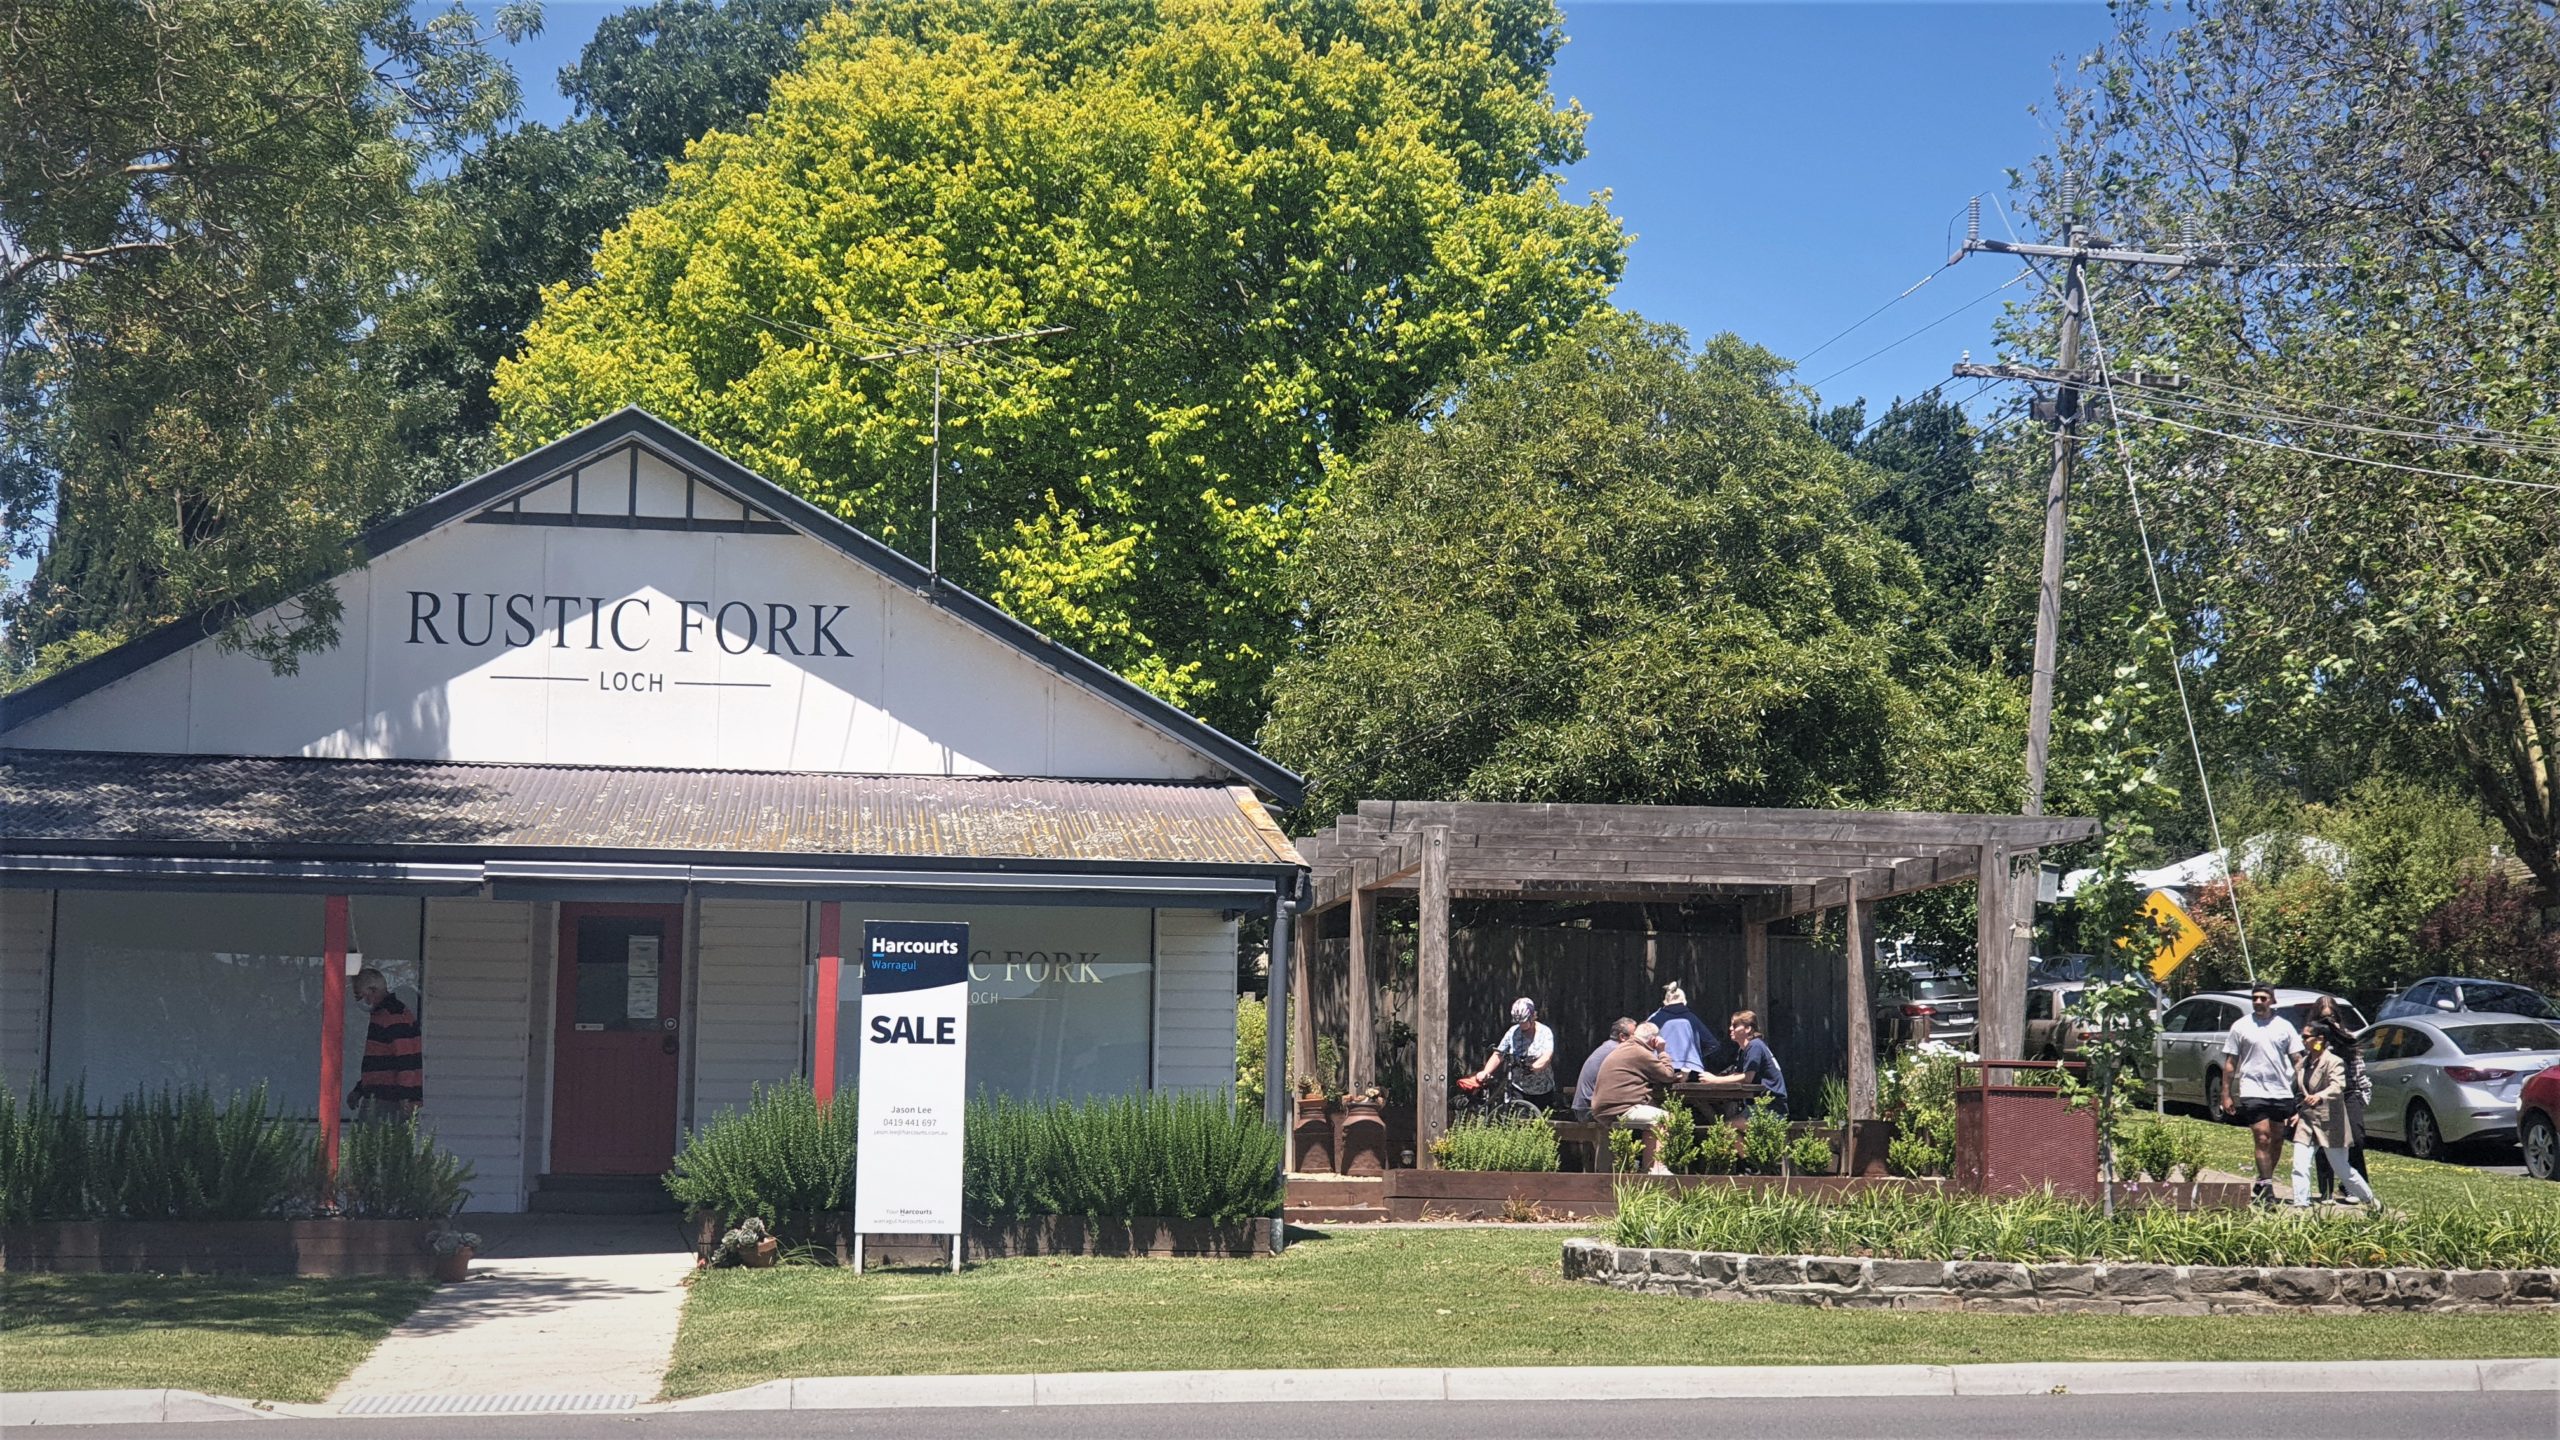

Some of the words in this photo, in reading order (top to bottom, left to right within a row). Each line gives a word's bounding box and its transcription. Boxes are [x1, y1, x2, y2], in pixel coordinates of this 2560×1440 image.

[404, 590, 651, 652] RUSTIC
[674, 599, 855, 658] FORK
[600, 670, 664, 693] LOCH
[871, 937, 959, 955] Harcourts
[871, 960, 917, 972] Warragul
[1003, 951, 1104, 984] FORK
[968, 991, 999, 1005] OCH
[870, 1015, 956, 1045] SALE
[891, 1106, 916, 1114] Jason
[917, 1106, 932, 1114] Lee
[883, 1118, 904, 1127] 0419
[905, 1118, 920, 1127] 441
[921, 1118, 937, 1127] 697
